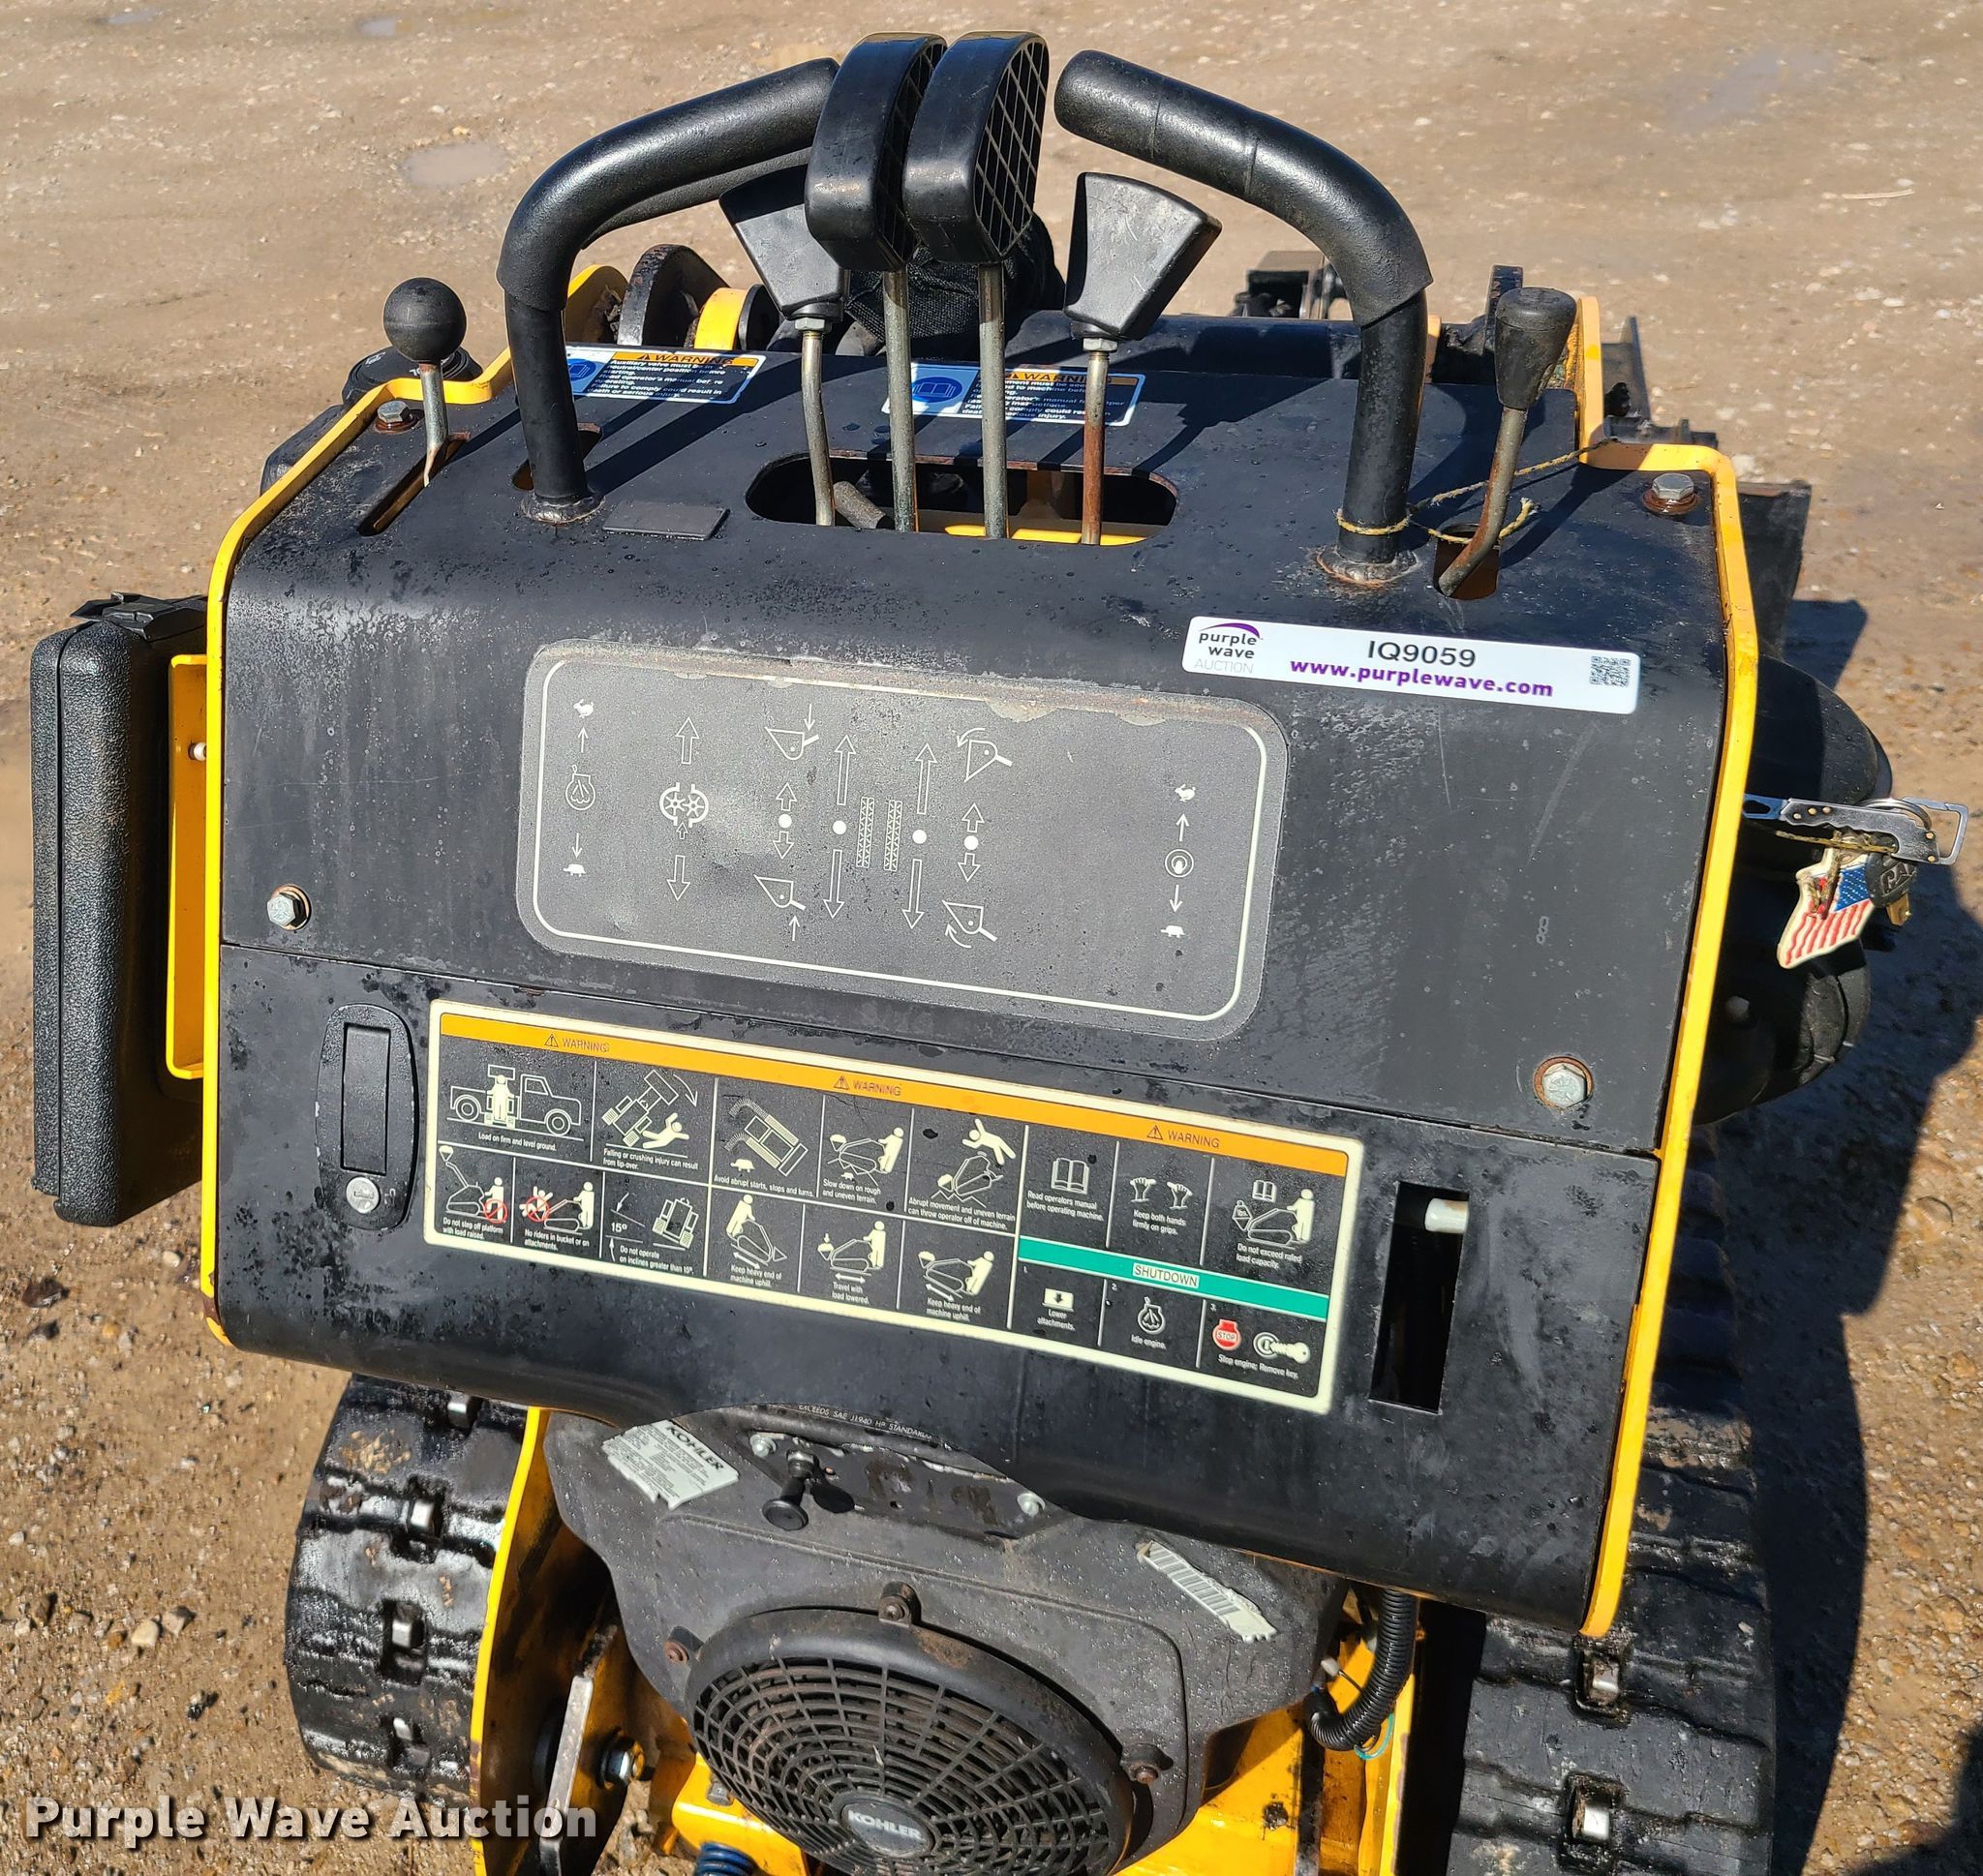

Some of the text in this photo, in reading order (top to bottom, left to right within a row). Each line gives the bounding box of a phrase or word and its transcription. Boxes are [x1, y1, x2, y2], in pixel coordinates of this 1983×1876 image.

[656, 355, 732, 365] WARNING
[1199, 632, 1257, 647] purple
[1208, 646, 1255, 659] wave
[1367, 640, 1476, 668] IQ9059
[1193, 658, 1254, 674] AUCTION
[1290, 660, 1553, 697] www.purplewave.com
[853, 1079, 902, 1097] WARNING
[478, 1133, 491, 1141] Load
[501, 1135, 511, 1144] firm
[523, 1138, 535, 1148] level
[536, 1142, 557, 1151] ground.
[1168, 1130, 1220, 1148] WARNING
[603, 1158, 616, 1166] from
[604, 1148, 621, 1159] Falling
[629, 1154, 654, 1164] crushing
[655, 1157, 669, 1166] injury
[683, 1162, 698, 1170] result
[714, 1174, 729, 1184] Avoid
[730, 1178, 748, 1188] abrupt
[749, 1181, 767, 1191] starts,
[769, 1184, 784, 1193] stops
[798, 1188, 815, 1197] turns.
[823, 1178, 838, 1188] Slow
[839, 1181, 854, 1191] down
[864, 1187, 881, 1195] rough
[835, 1192, 856, 1200] uneven
[856, 1194, 877, 1204] terrain.
[1027, 1191, 1044, 1199] Read
[1075, 1199, 1097, 1210] manual
[908, 1196, 929, 1207] Abrupt
[930, 1200, 960, 1212] movement
[974, 1208, 995, 1219] uneven
[995, 1211, 1016, 1221] terrain
[1026, 1200, 1104, 1222] before operating machine.
[443, 1217, 451, 1225] Do
[451, 1219, 460, 1227] not
[461, 1221, 473, 1229] step
[482, 1224, 503, 1234] platform
[920, 1208, 937, 1218] throw
[938, 1212, 962, 1223] operator
[980, 1219, 1007, 1230] machine.
[1133, 1209, 1186, 1226] Keep both hands
[1132, 1219, 1150, 1231] firmly
[1160, 1225, 1178, 1235] grips.
[525, 1228, 533, 1237] No
[534, 1229, 549, 1240] riders
[550, 1232, 556, 1241] in
[557, 1233, 574, 1245] bucket
[620, 1245, 659, 1259] Do not operate
[1248, 1246, 1259, 1255] not
[1260, 1249, 1284, 1258] exceed
[1284, 1254, 1302, 1263] rated
[627, 1256, 649, 1267] inclines
[650, 1260, 669, 1270] greater
[670, 1262, 683, 1273] than
[1236, 1253, 1279, 1269] load capacity.
[730, 1263, 746, 1275] Keep
[747, 1266, 762, 1278] heavy
[763, 1270, 775, 1279] end
[1134, 1265, 1198, 1286] SHUTDOWN
[833, 1281, 850, 1291] Travel
[832, 1290, 870, 1306] load lowered.
[927, 1297, 981, 1315] Keep heavy end of
[1048, 1309, 1067, 1318] Lower
[1037, 1316, 1076, 1332] attachments.
[1131, 1334, 1167, 1350] Idle engine.
[1218, 1331, 1236, 1341] STOP
[1218, 1353, 1234, 1365] Stop
[1259, 1363, 1286, 1376] Remove
[1286, 1369, 1298, 1379] key.
[833, 1410, 848, 1420] SAE
[666, 1426, 724, 1470] KOHLER
[848, 1809, 927, 1841] KOHLER
